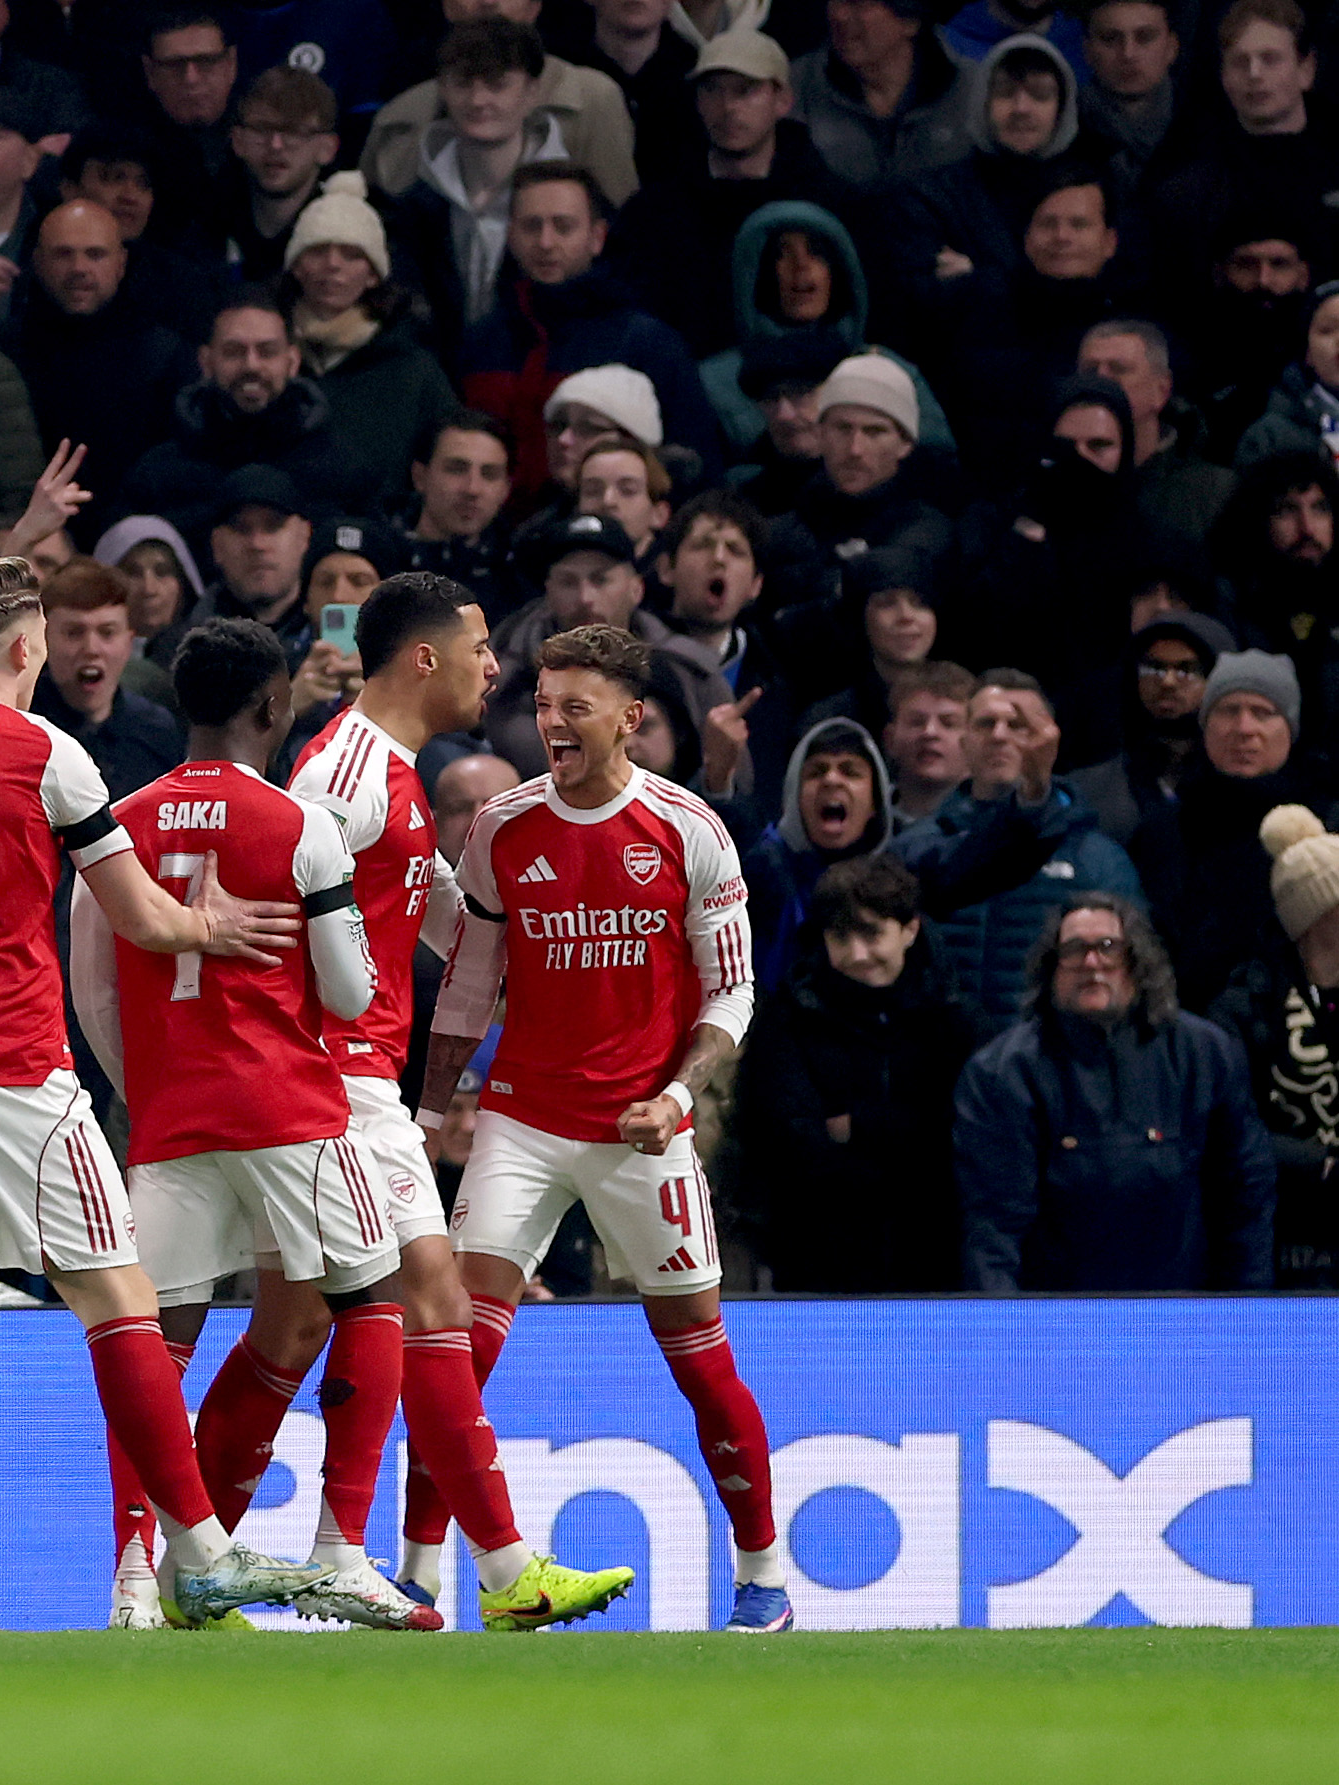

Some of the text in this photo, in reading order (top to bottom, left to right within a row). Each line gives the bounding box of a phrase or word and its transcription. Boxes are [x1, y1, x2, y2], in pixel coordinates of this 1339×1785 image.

[182, 767, 221, 778] Arsenal
[157, 800, 227, 831] SAKA
[158, 853, 206, 1001] 7
[518, 902, 668, 940] Emirates
[545, 940, 646, 970] FLY BETTER
[658, 1176, 692, 1238] 4
[119, 1606, 135, 1629] 7
